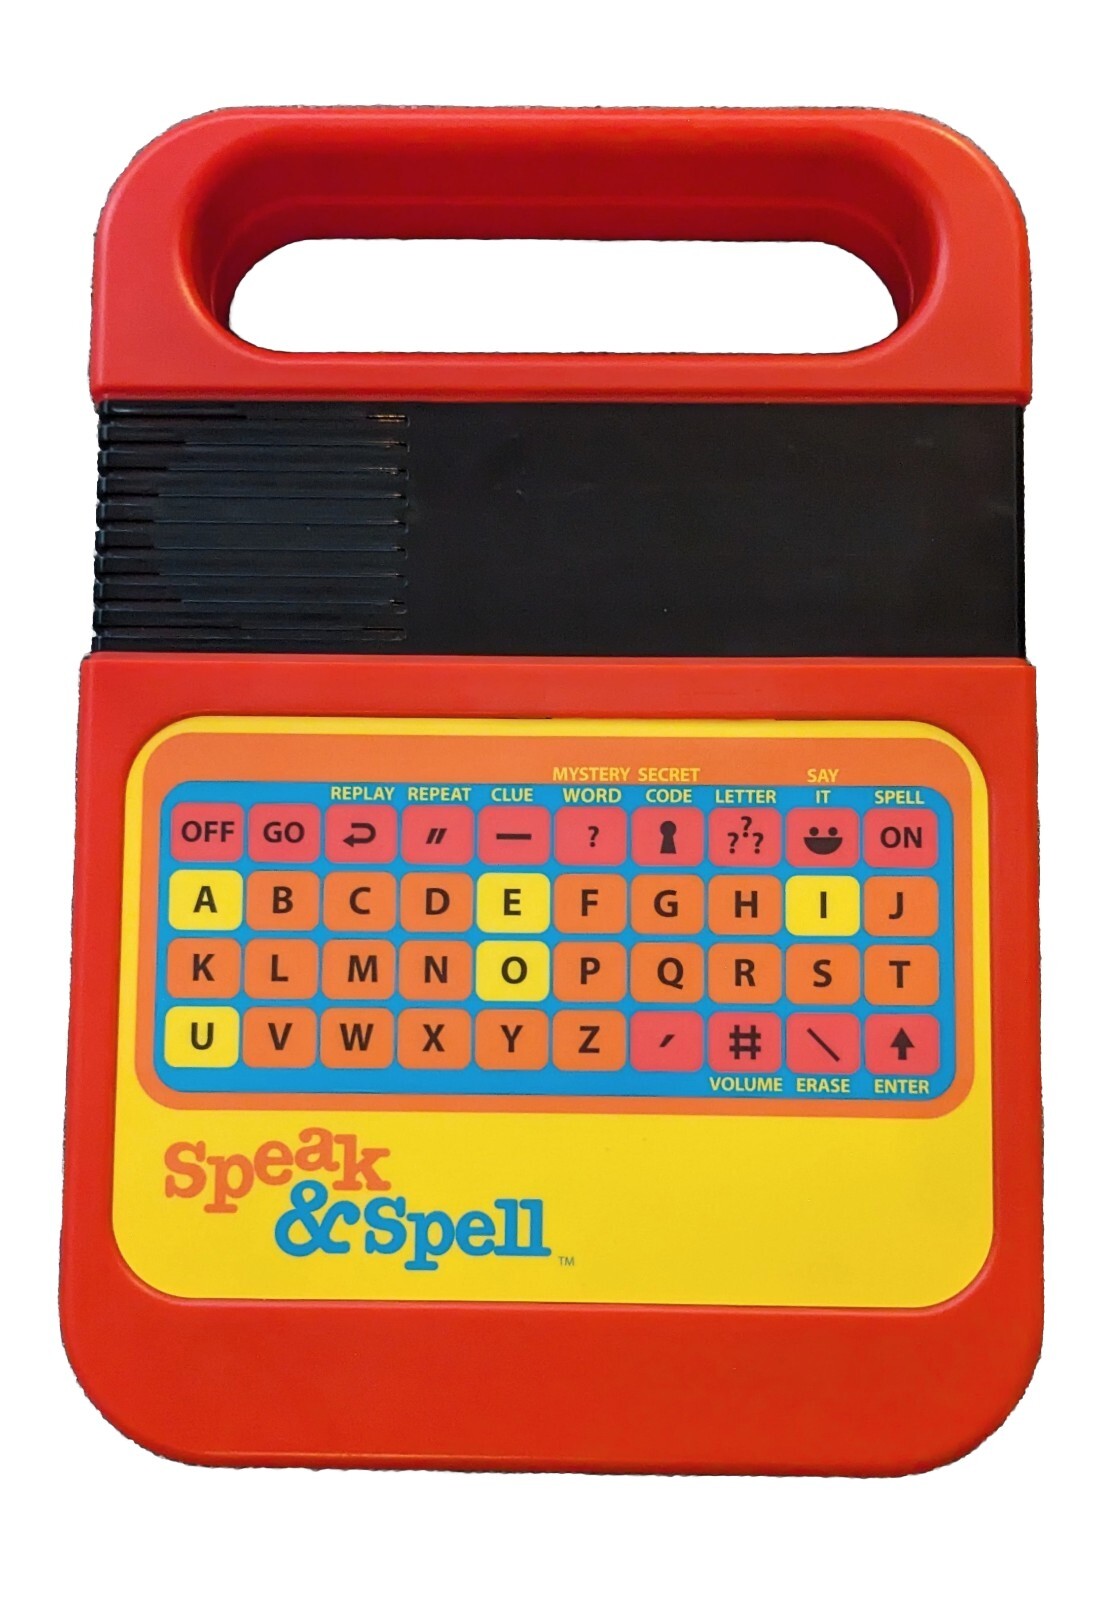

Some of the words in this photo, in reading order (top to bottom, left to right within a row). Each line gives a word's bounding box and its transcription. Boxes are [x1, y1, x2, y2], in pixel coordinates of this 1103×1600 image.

[552, 766, 631, 782] MYSTERY
[637, 767, 701, 783] SECRET
[806, 768, 840, 784] SAY
[330, 786, 396, 801] REPLAY
[407, 787, 472, 802] REPEAT
[491, 787, 534, 802] CLUE
[562, 788, 622, 803] WORD
[645, 788, 692, 804] CODE
[715, 789, 777, 804] LETTER
[816, 790, 831, 804] IT
[874, 790, 925, 805] SPELL
[181, 820, 235, 843] OFF
[263, 821, 306, 844] GO
[879, 826, 923, 849] ON
[193, 885, 218, 914] A
[272, 886, 294, 914] B
[349, 886, 372, 915] C
[425, 887, 450, 915] D
[503, 888, 522, 916] E
[581, 889, 599, 917] F
[653, 889, 679, 918] G
[734, 890, 758, 918] H
[820, 891, 827, 919] I
[888, 891, 904, 920] J
[192, 953, 215, 981] K
[271, 954, 289, 982] L
[347, 954, 379, 983] M
[424, 955, 448, 983] N
[500, 956, 528, 984] O
[580, 957, 600, 985] P
[657, 956, 684, 990] Q
[734, 958, 756, 987] R
[812, 959, 833, 988] S
[888, 960, 911, 988] T
[190, 1022, 214, 1050] U
[267, 1022, 293, 1051] V
[339, 1023, 374, 1051] W
[422, 1023, 446, 1052] X
[500, 1024, 523, 1053] Y
[578, 1025, 600, 1054] Z
[709, 1076, 783, 1092] VOLUME
[796, 1078, 851, 1093] ERASE
[874, 1079, 930, 1095] ENTER
[163, 1126, 392, 1214] Speak
[273, 1179, 361, 1258] &
[363, 1196, 552, 1271] Spell
[557, 1256, 575, 1266] TM
